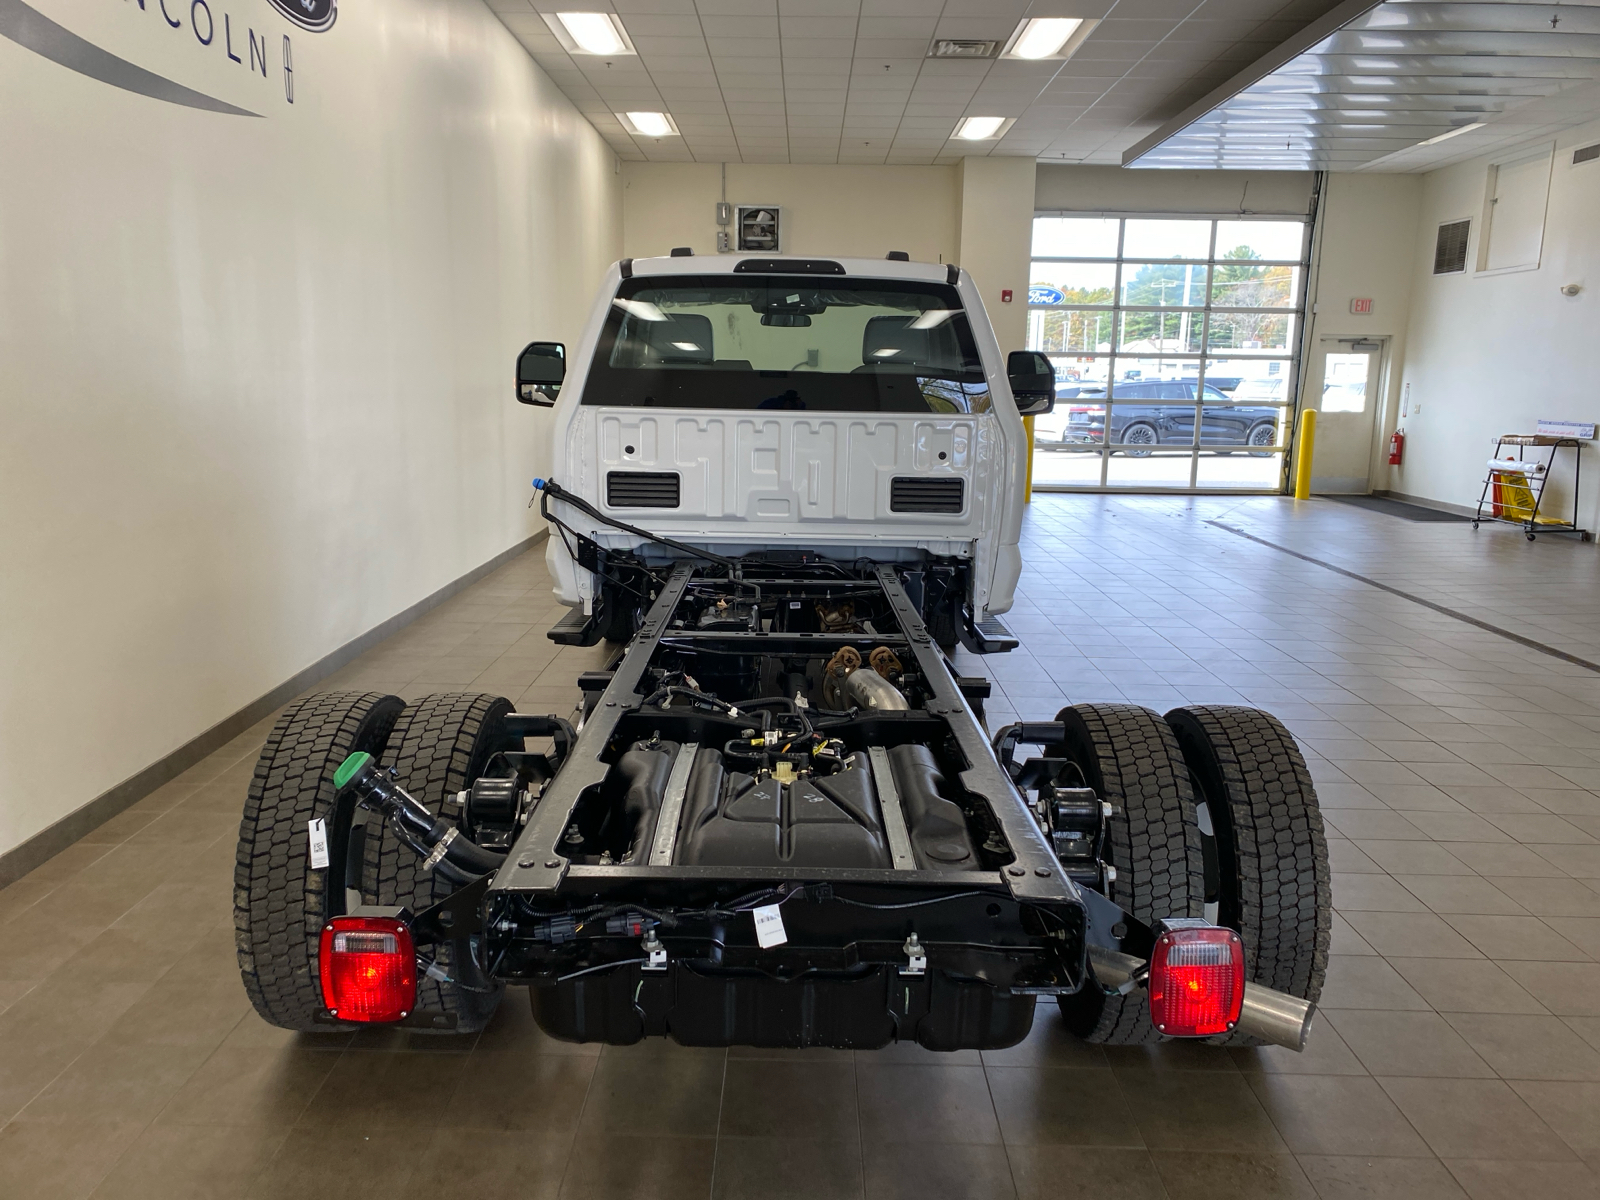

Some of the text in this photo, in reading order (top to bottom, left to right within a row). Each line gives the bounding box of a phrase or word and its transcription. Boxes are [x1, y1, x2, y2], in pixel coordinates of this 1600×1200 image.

[124, 0, 267, 78] COLN
[1028, 289, 1056, 303] Ford
[1354, 298, 1372, 312] EXIT
